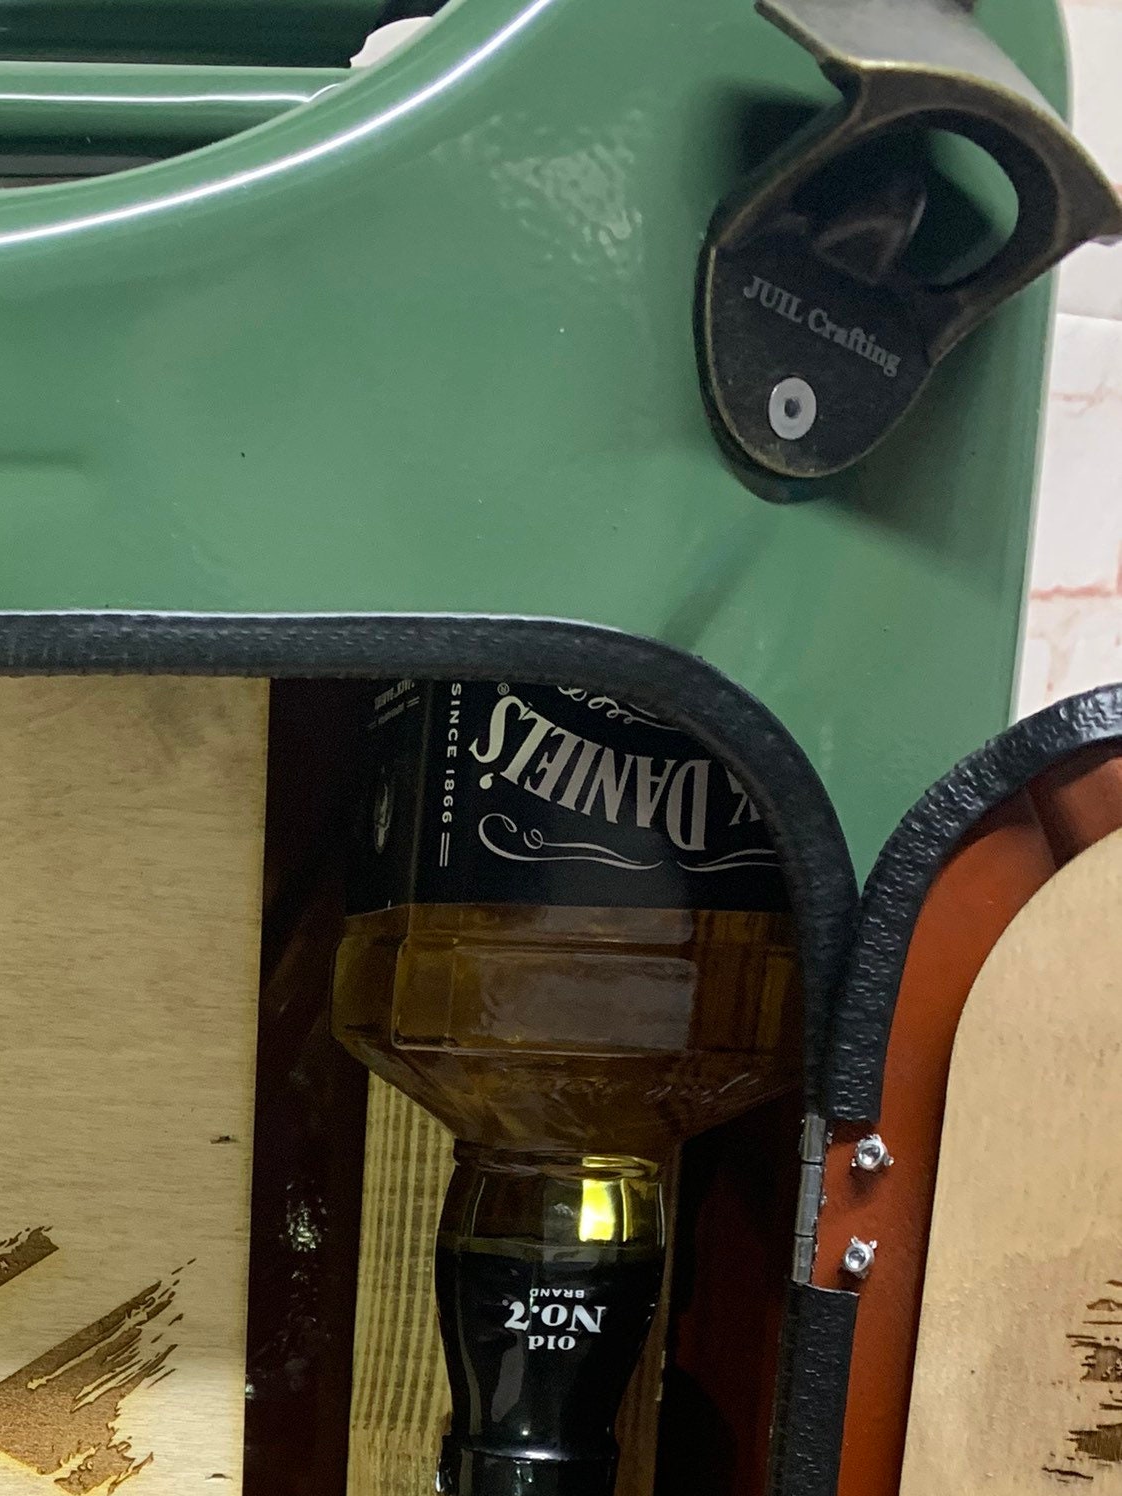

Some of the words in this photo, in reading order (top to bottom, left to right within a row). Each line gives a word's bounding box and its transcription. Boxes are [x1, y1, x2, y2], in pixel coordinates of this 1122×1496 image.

[743, 276, 803, 323] JUIL
[808, 308, 901, 377] Crafting
[447, 683, 462, 758] SINCE
[441, 769, 455, 823] 1866
[468, 695, 711, 851] DANIEL'S
[529, 1288, 585, 1299] BRAND
[527, 1335, 576, 1350] Old
